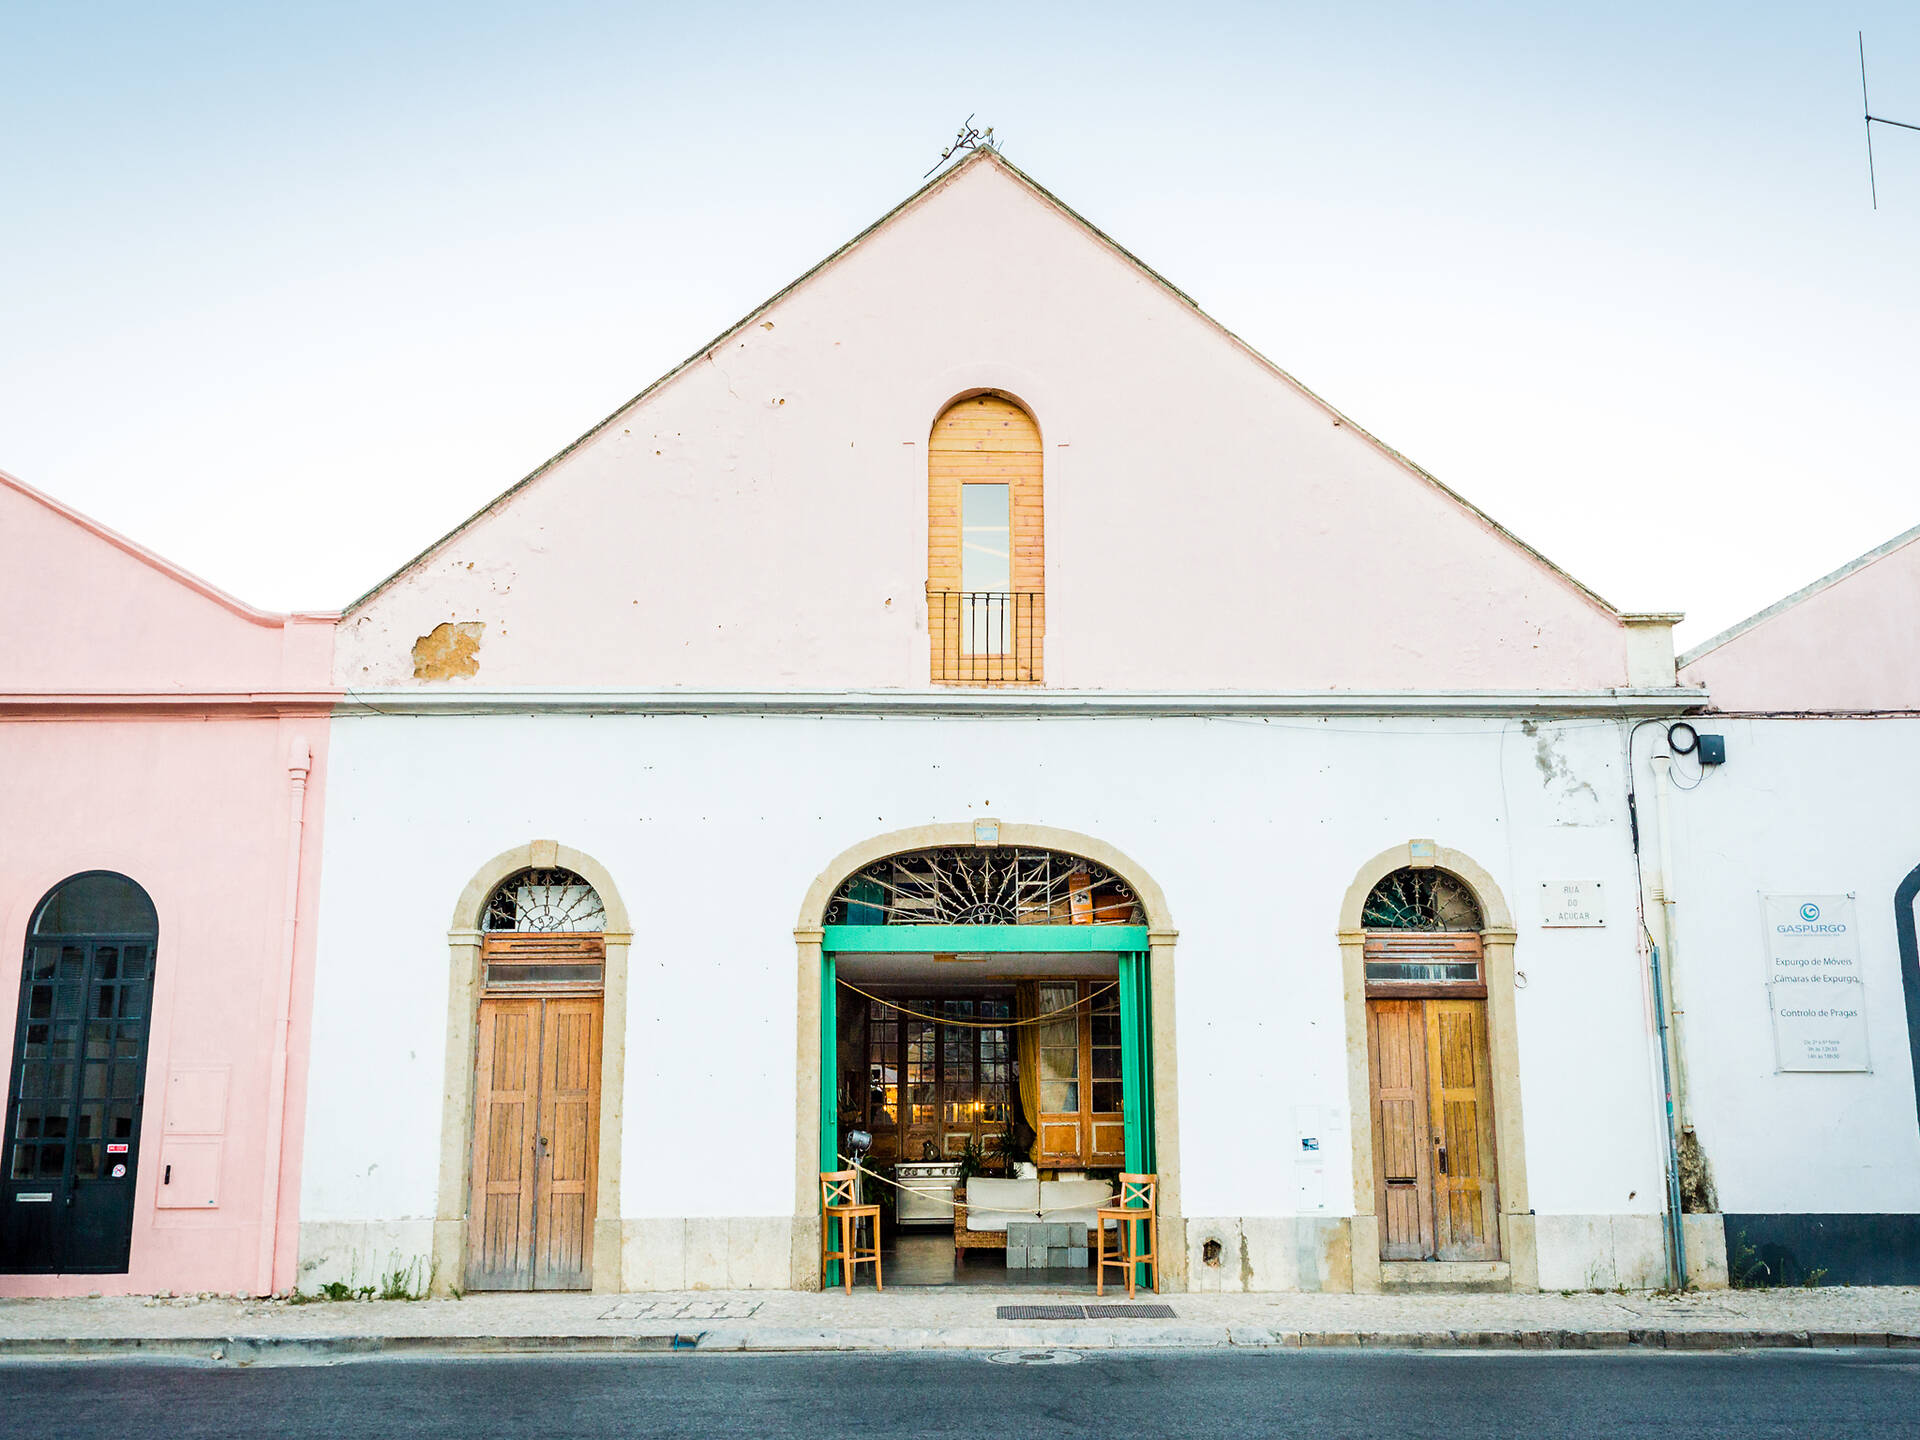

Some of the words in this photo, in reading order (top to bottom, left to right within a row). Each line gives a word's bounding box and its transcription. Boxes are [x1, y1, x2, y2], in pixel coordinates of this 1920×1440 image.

[1567, 899, 1578, 907] DO
[1776, 924, 1847, 933] GASPURGO
[1775, 958, 1810, 967] Expurgo
[1811, 958, 1822, 966] de
[1823, 957, 1853, 966] Móveis
[1811, 974, 1822, 983] de
[1823, 974, 1858, 984] Expurgo
[1780, 1008, 1817, 1017] Controlo
[1818, 1008, 1829, 1017] de
[1830, 1008, 1858, 1019] Pragas
